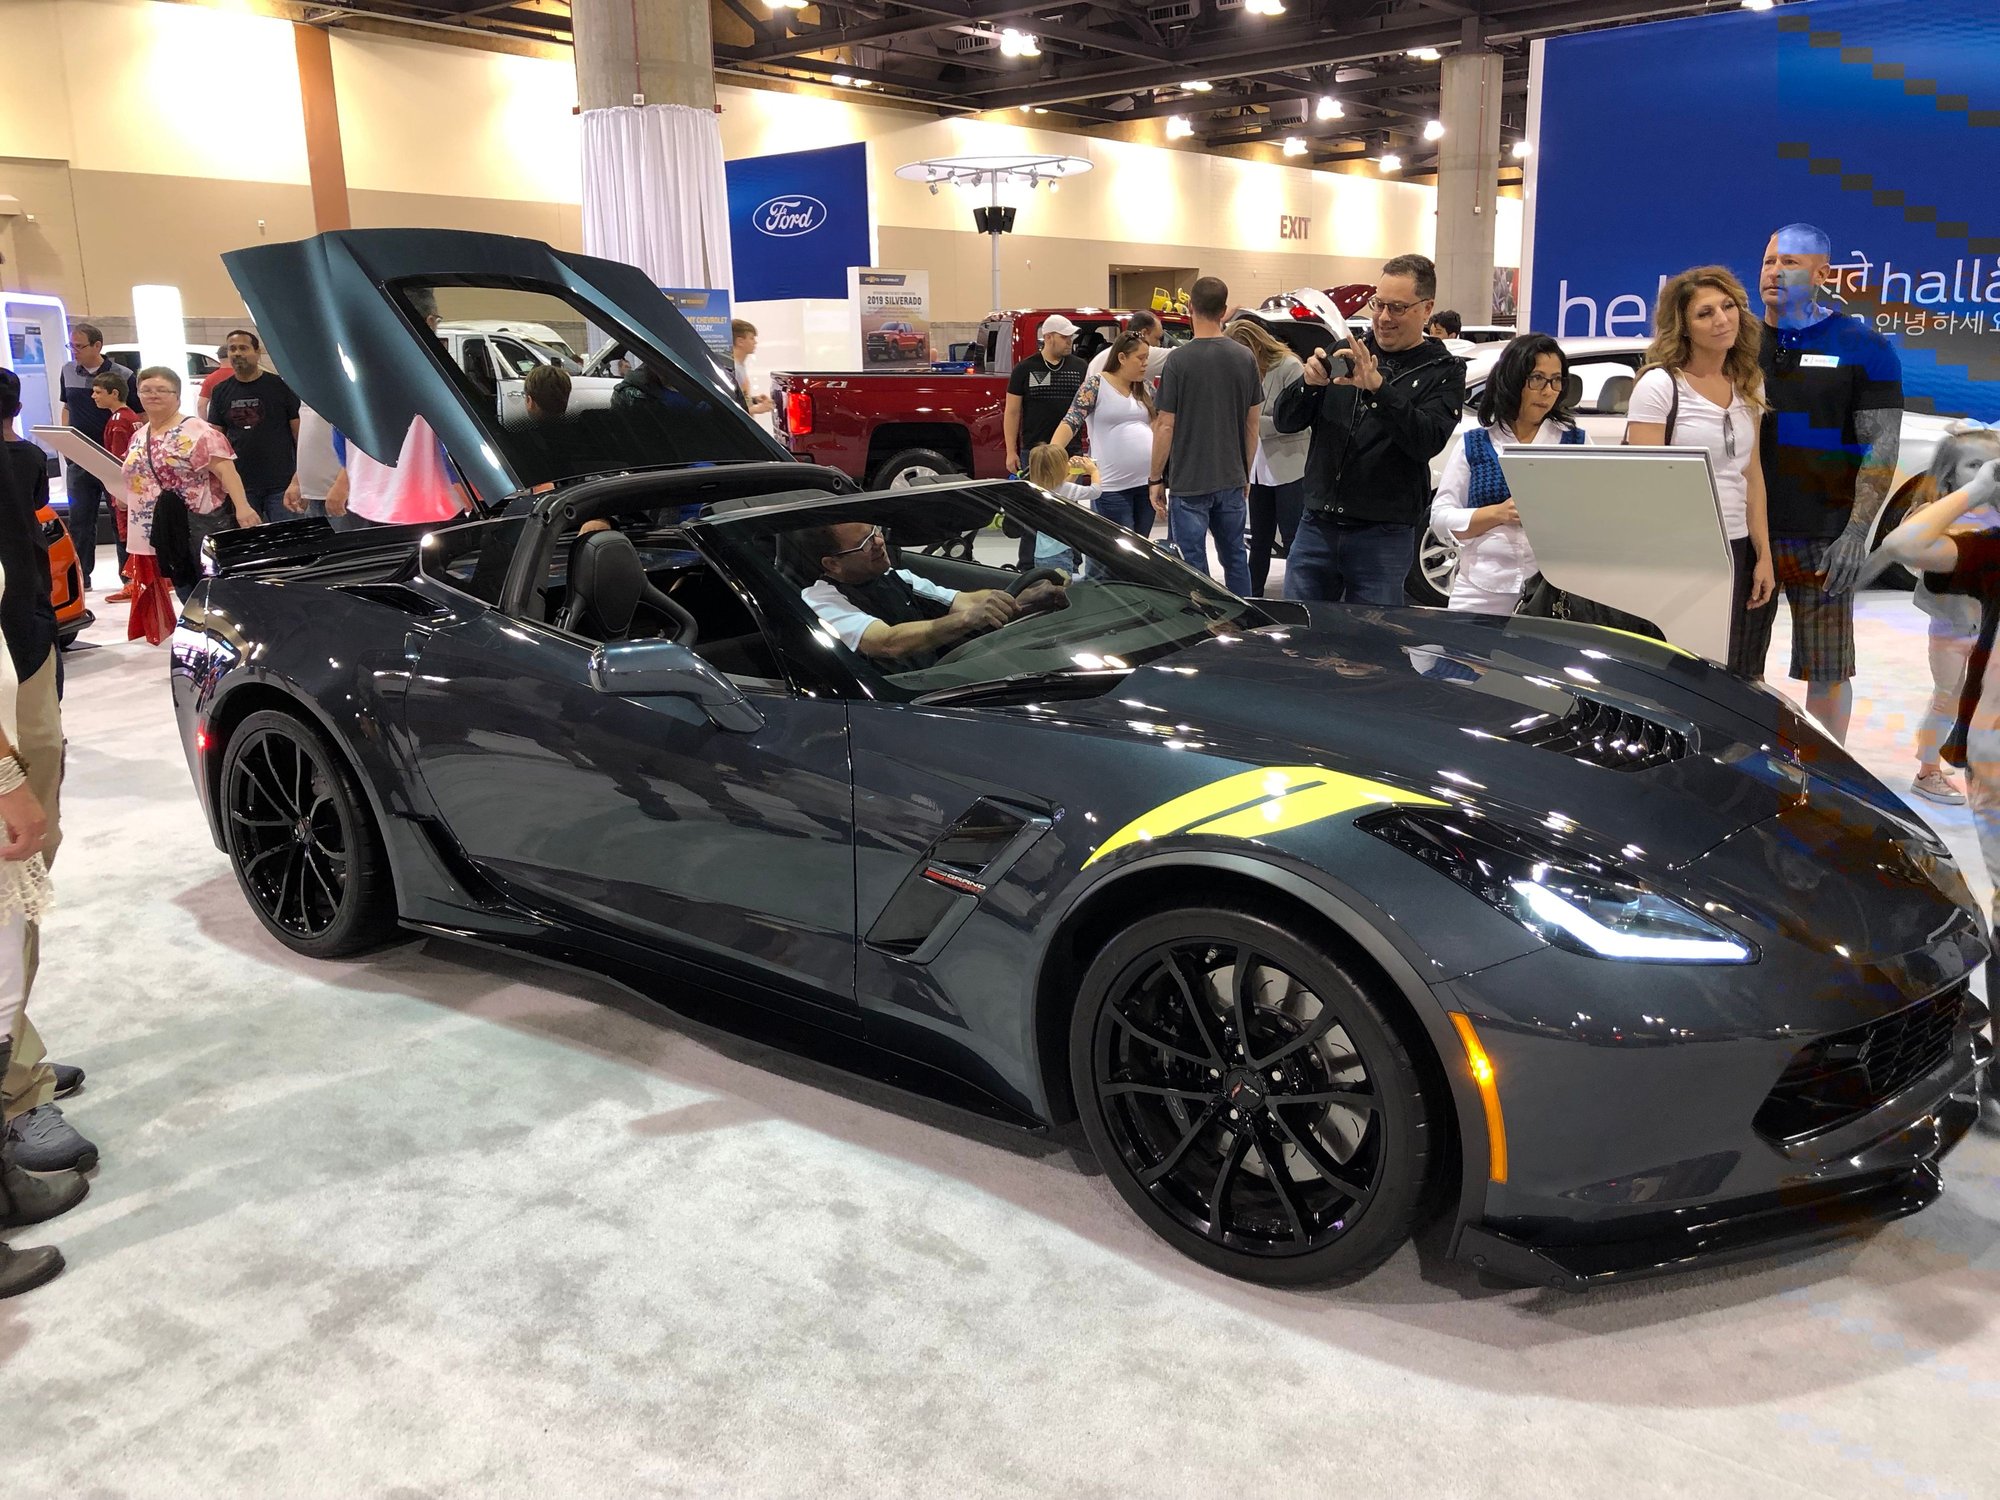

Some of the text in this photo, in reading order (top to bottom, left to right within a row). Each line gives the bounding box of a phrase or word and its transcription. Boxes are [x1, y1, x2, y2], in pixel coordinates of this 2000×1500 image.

[765, 200, 814, 231] Ford
[1280, 214, 1312, 240] EXIT
[867, 295, 922, 306] 2019 SILVERADO
[696, 316, 728, 324] CHEVROLET
[946, 873, 987, 890] GRAND
